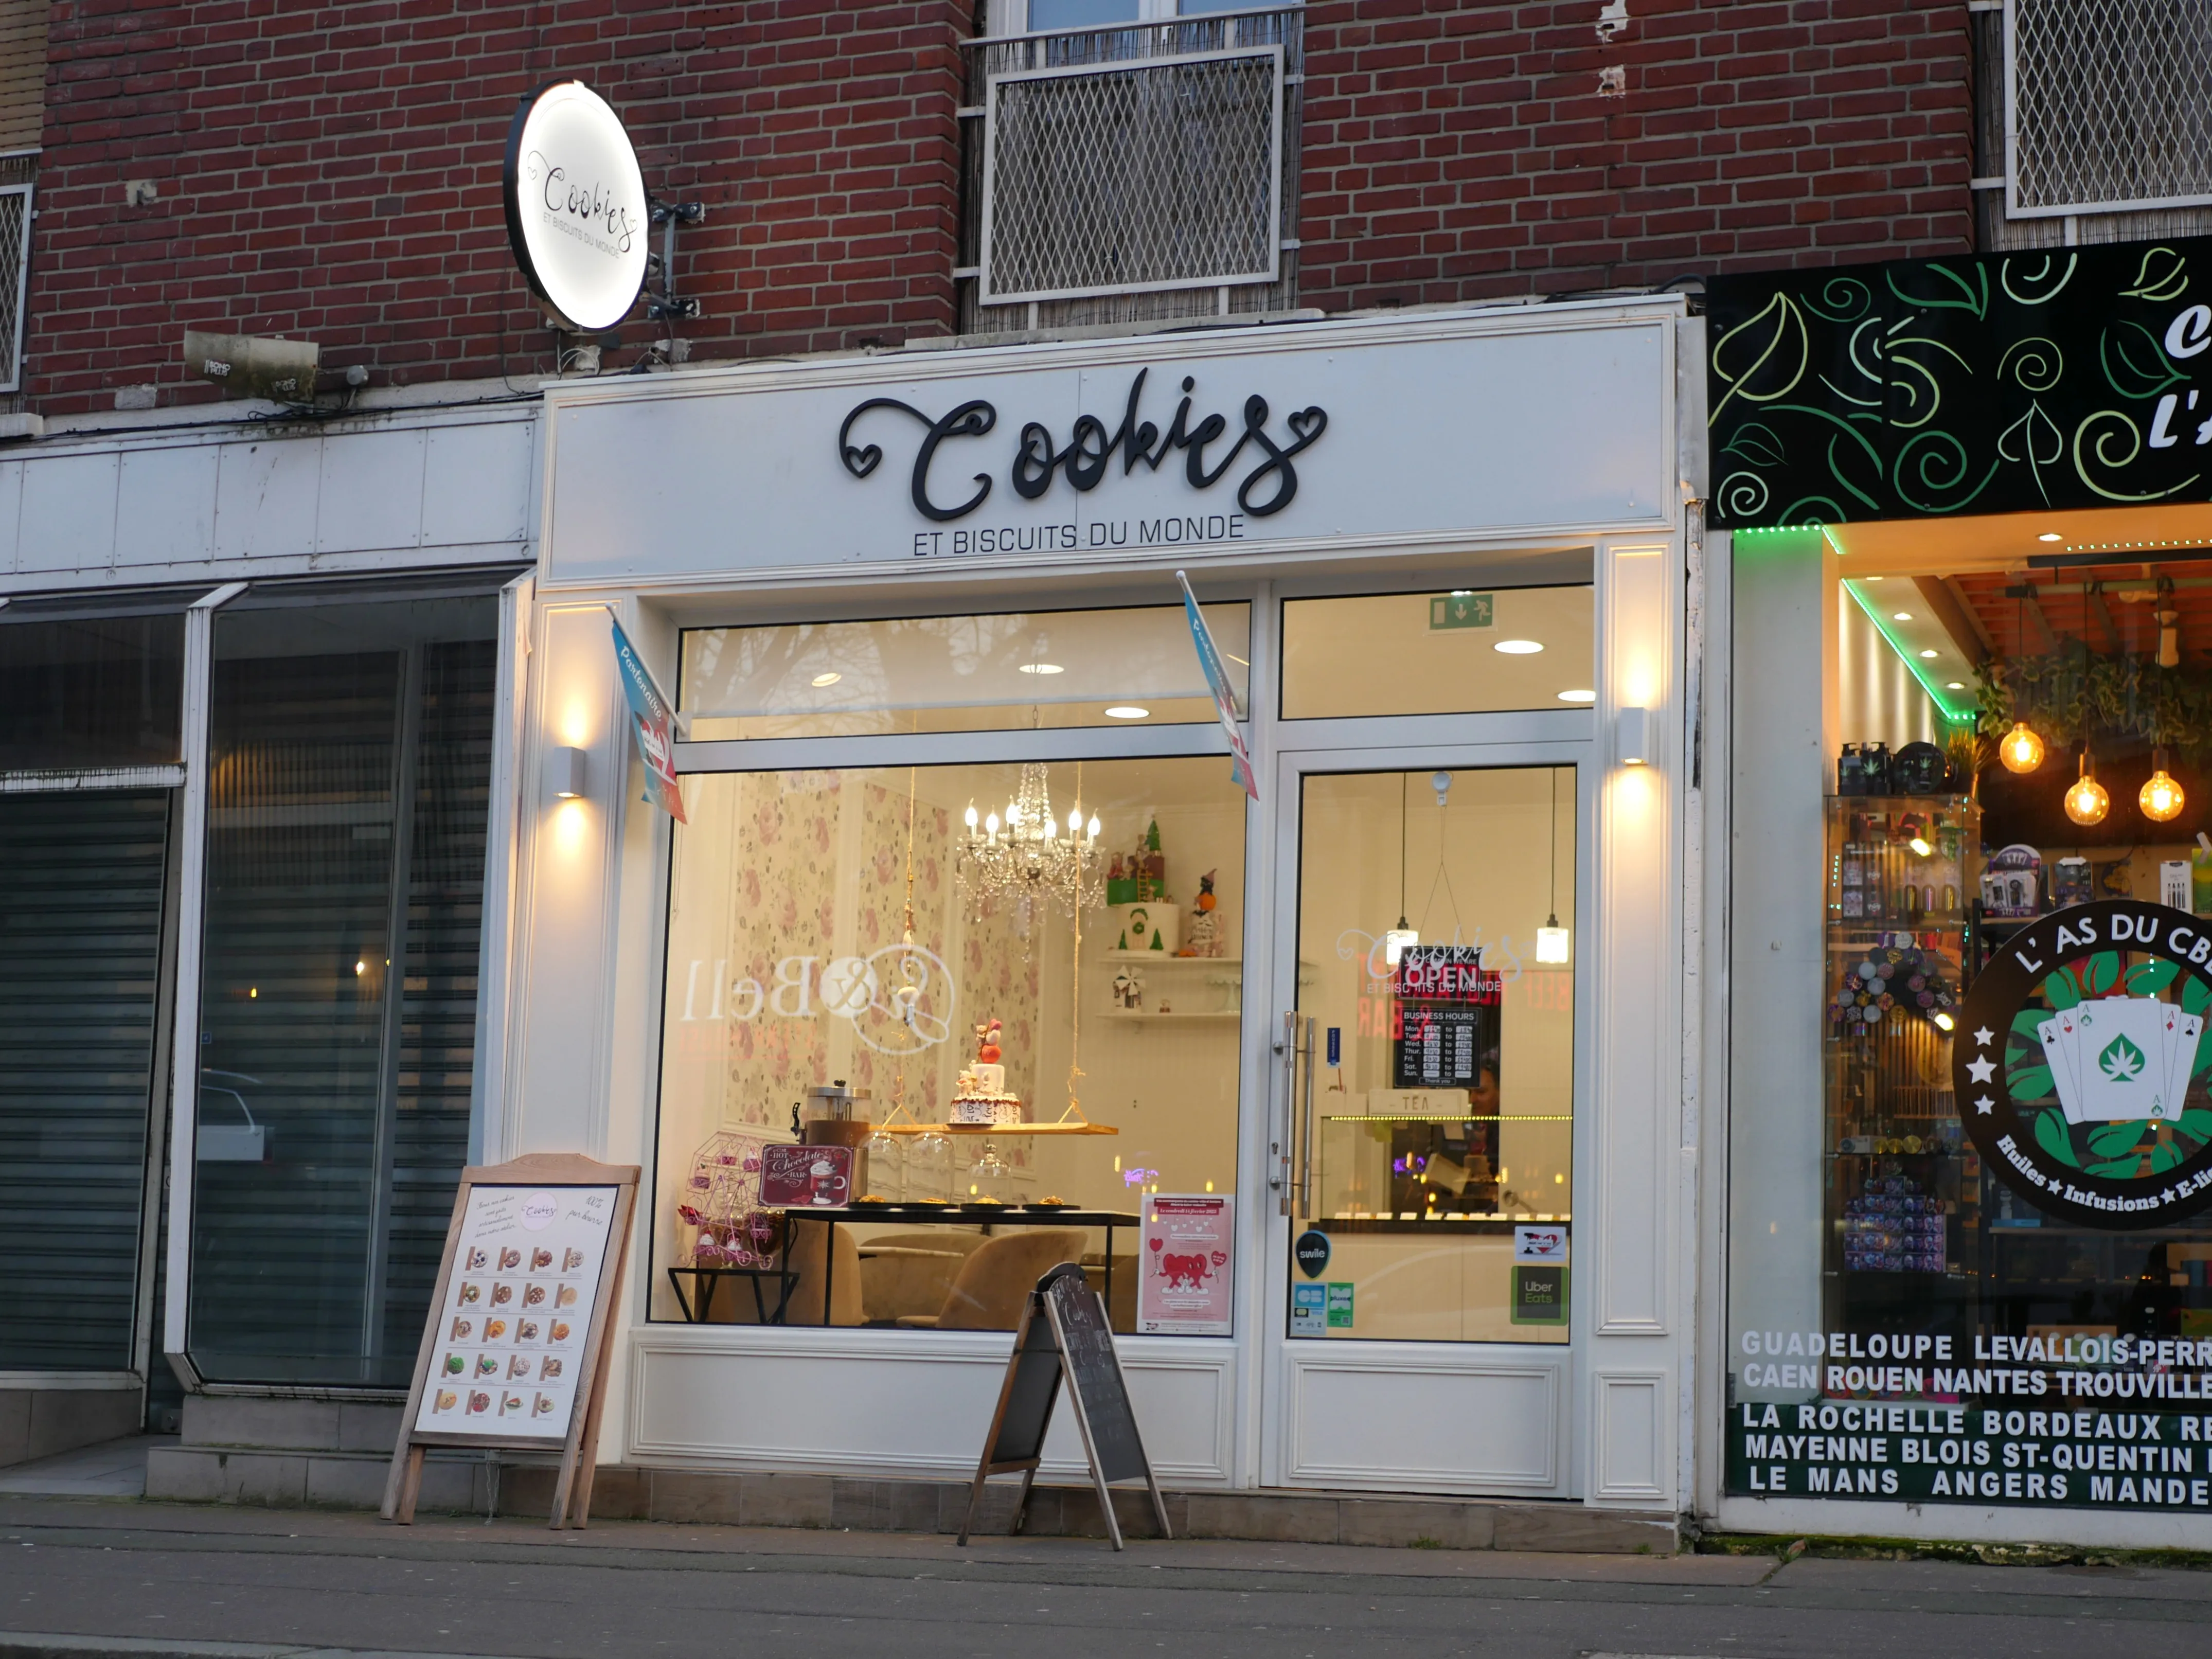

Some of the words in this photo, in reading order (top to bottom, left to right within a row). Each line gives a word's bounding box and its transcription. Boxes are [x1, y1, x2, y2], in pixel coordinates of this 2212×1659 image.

[533, 157, 637, 253] Cookies
[543, 212, 552, 223] ET
[553, 215, 582, 241] BISCUITS
[584, 233, 594, 246] DU
[595, 239, 620, 259] MONDE
[840, 367, 1328, 521] Cookies
[914, 532, 943, 556] ET
[954, 525, 1077, 554] BISCUITS
[1090, 521, 1127, 546] DU
[1139, 514, 1244, 544] MONDE
[620, 645, 662, 722] Partenaire
[2057, 917, 2097, 954] AS
[2112, 914, 2159, 943] DU
[1337, 924, 1536, 983] Cookies
[1405, 967, 1477, 989] OPEN
[1458, 980, 1502, 992] MONDE
[1404, 1011, 1444, 1020] BUSINESS
[1445, 1012, 1474, 1021] HOURS
[1402, 1096, 1429, 1111] TEA
[766, 1150, 823, 1171] Chocolate
[773, 1151, 789, 1159] HOT
[1996, 1134, 2048, 1187] Huiles
[2063, 1184, 2161, 1212] Infusions
[566, 1209, 581, 1221] pur
[585, 1196, 604, 1208] 100%
[1299, 1247, 1326, 1258] swile
[1525, 1281, 1553, 1292] Uber
[1525, 1293, 1553, 1304] Eats
[1742, 1331, 1952, 1361] GUADELOUPE
[1744, 1363, 1817, 1389] CAEN
[1827, 1365, 1923, 1393] ROUEN
[1933, 1368, 2047, 1396] NANTES
[1743, 1403, 1780, 1428] LA
[1798, 1405, 1964, 1434] ROCHELLE
[1983, 1410, 2161, 1440] BORDEAUX
[1745, 1434, 1888, 1463] MAYENNE
[1902, 1438, 1990, 1465] BLOIS
[2003, 1442, 2192, 1473] ST-QUENTIN
[1750, 1466, 1786, 1490] LE
[1808, 1467, 1899, 1494] MANS
[1932, 1470, 2068, 1500] ANGERS
